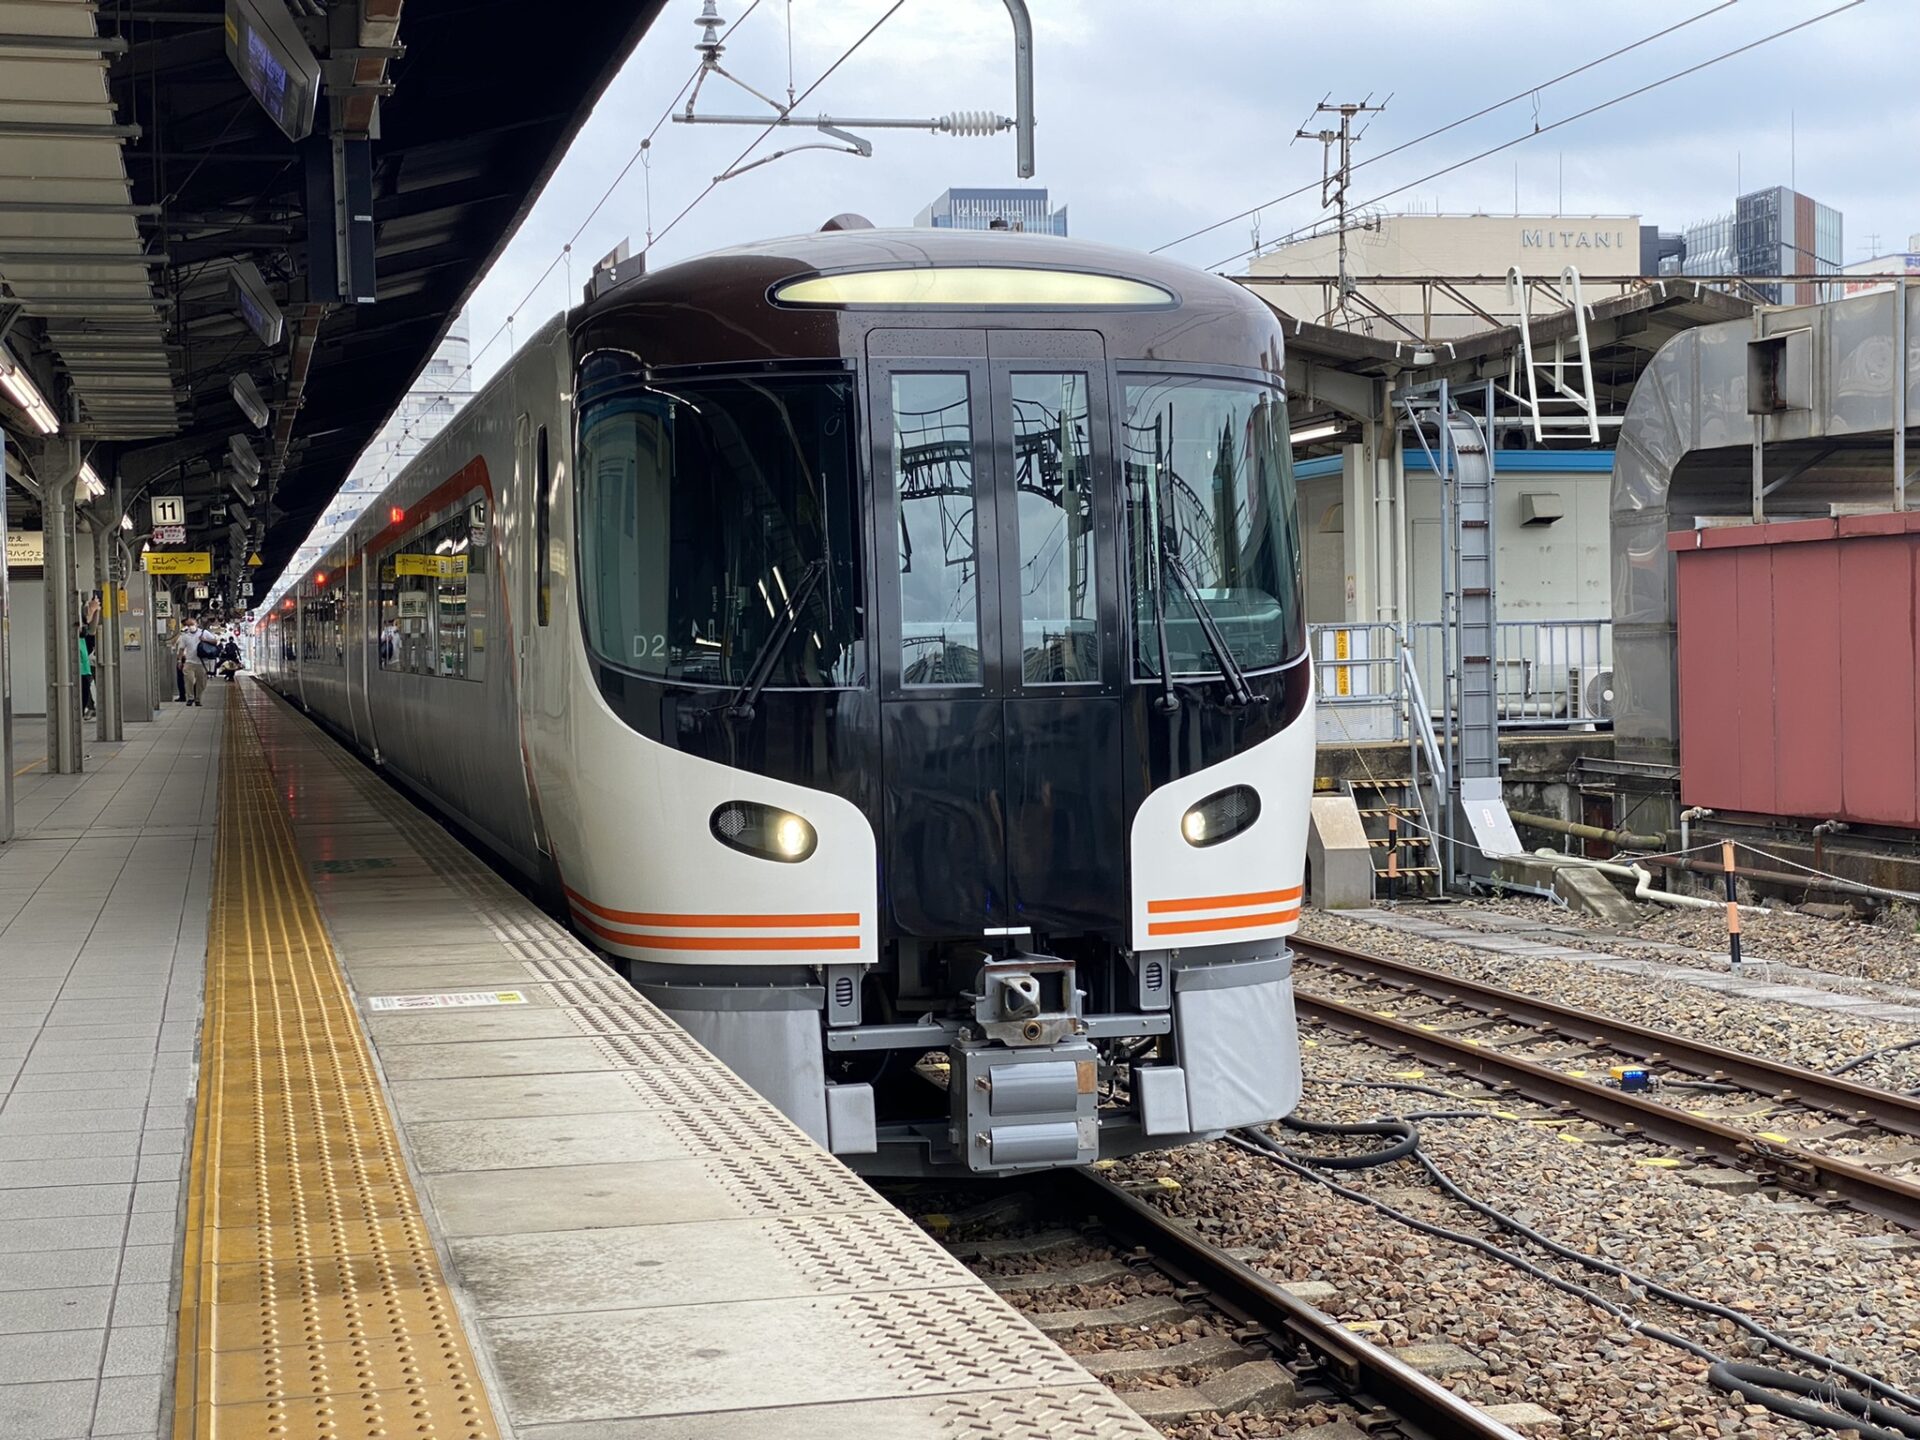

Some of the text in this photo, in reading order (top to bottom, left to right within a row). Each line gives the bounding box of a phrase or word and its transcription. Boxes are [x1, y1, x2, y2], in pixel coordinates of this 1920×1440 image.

[1521, 228, 1623, 249] MITANI
[157, 501, 176, 520] 11
[152, 556, 206, 565] エレベーター
[244, 583, 251, 592] 3
[633, 635, 666, 657] D2
